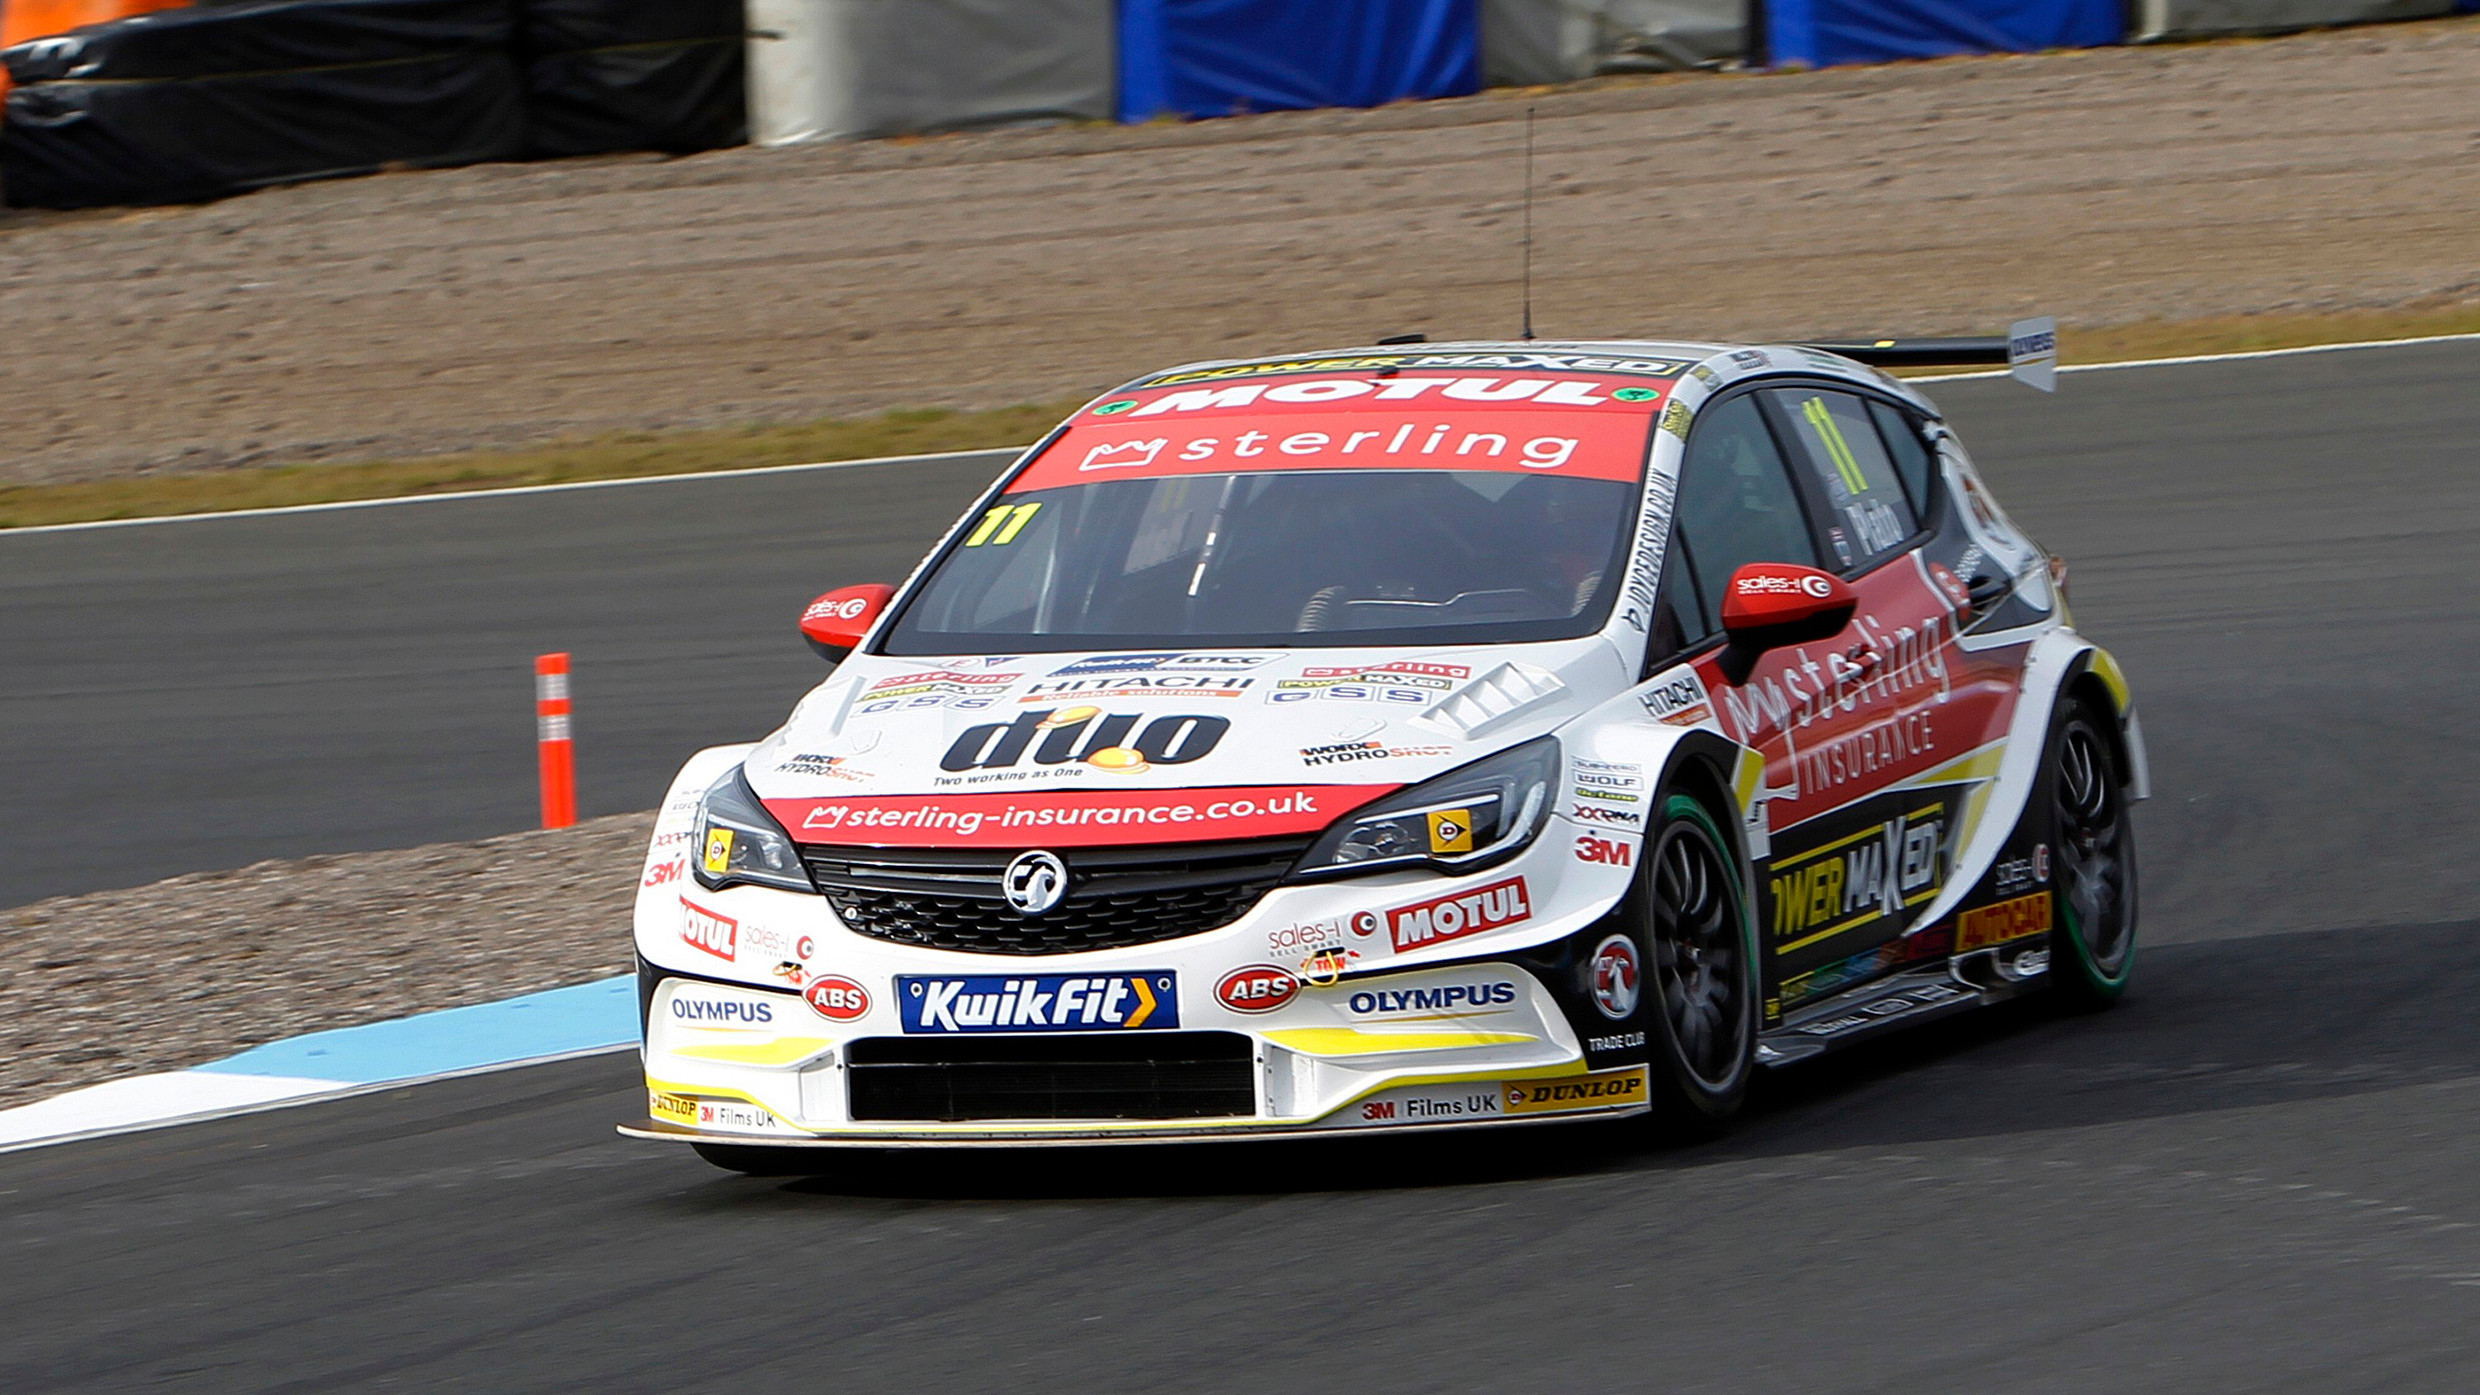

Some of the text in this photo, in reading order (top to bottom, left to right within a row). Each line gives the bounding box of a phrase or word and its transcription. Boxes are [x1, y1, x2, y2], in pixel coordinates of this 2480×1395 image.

[1413, 354, 1669, 374] MAXED
[1128, 377, 1609, 417] MOTUL
[1177, 423, 1580, 469] sterling
[1802, 396, 1870, 495] 11
[965, 502, 1042, 547] 11
[1027, 677, 1256, 694] HITACHI
[1365, 674, 1446, 688] MAXED
[1638, 676, 1704, 717] HITACHI
[939, 708, 1232, 773] duo
[1802, 710, 1935, 795] INSURANCE
[933, 768, 1084, 787] Two working as One
[846, 791, 1318, 835] sterling-insurance.co.uk
[1575, 836, 1631, 867] 3M
[644, 858, 686, 887] 3M
[680, 903, 734, 957] OTUL
[1396, 884, 1526, 947] MOTUL
[813, 986, 863, 1011] ABS
[1228, 976, 1290, 1000] ABS
[1349, 981, 1515, 1014] OLYMPUS
[672, 998, 773, 1023] OLYMPUS
[1588, 1035, 1624, 1051] TRADE
[1530, 1076, 1642, 1104] DUNLOP
[720, 1107, 752, 1126] Films
[755, 1109, 776, 1128] UK
[1361, 1094, 1498, 1121] 3M Films UK
